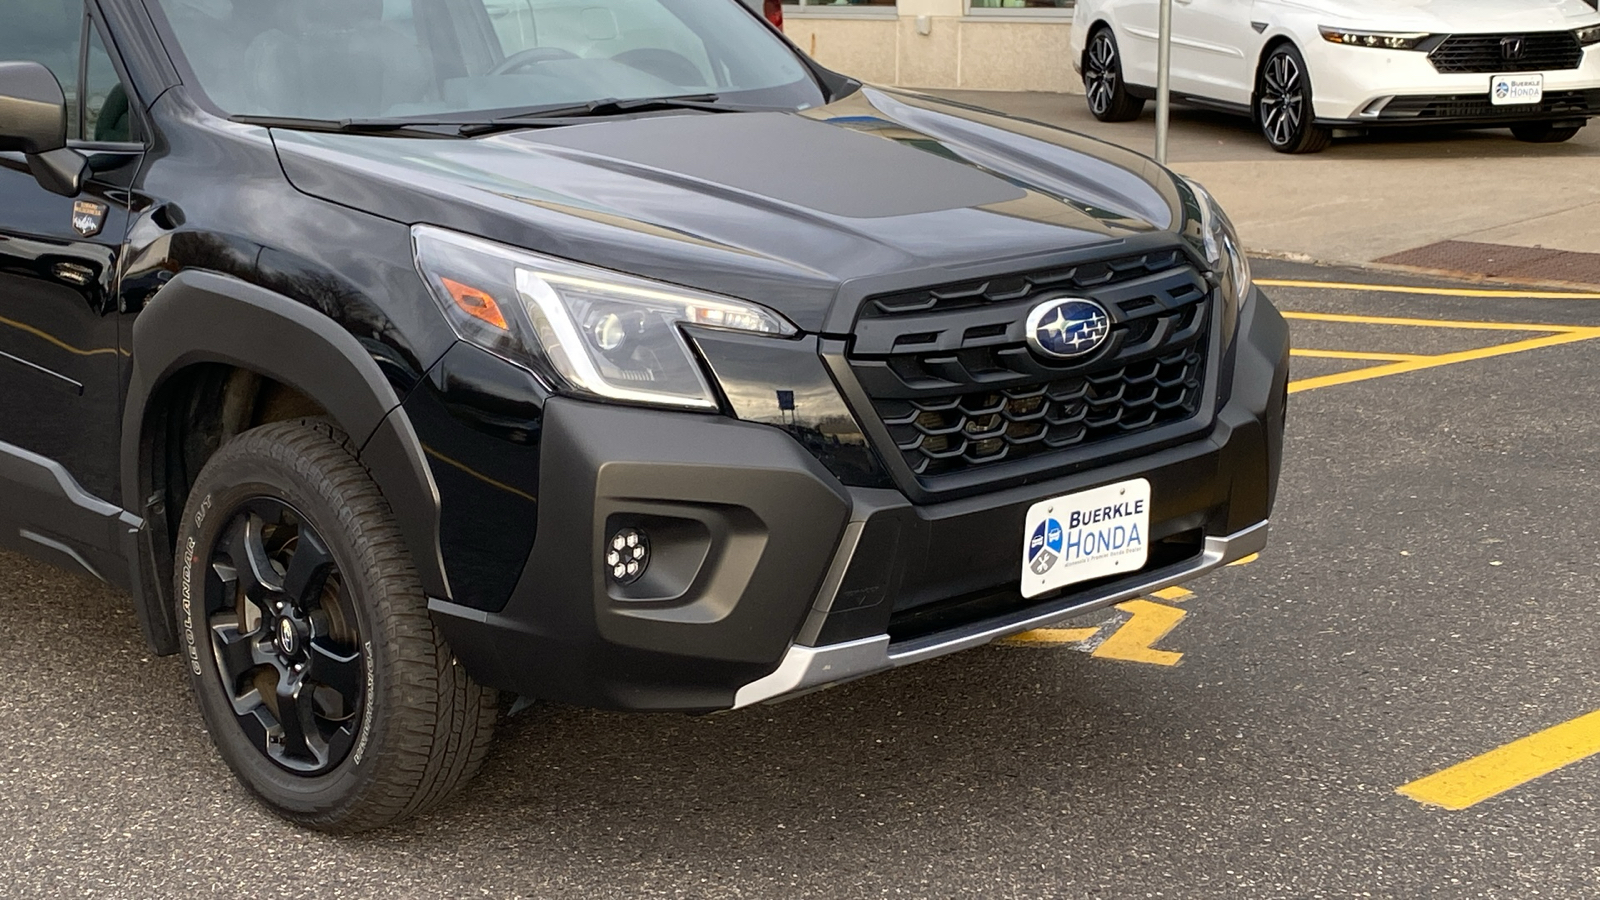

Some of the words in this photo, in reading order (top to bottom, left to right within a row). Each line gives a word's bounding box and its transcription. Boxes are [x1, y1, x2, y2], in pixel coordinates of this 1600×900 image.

[1511, 87, 1539, 97] HONDA
[1069, 500, 1144, 529] BUERKLE
[1065, 523, 1142, 561] HONDA
[181, 536, 202, 675] GEOLANDAR
[195, 494, 212, 528] A/T
